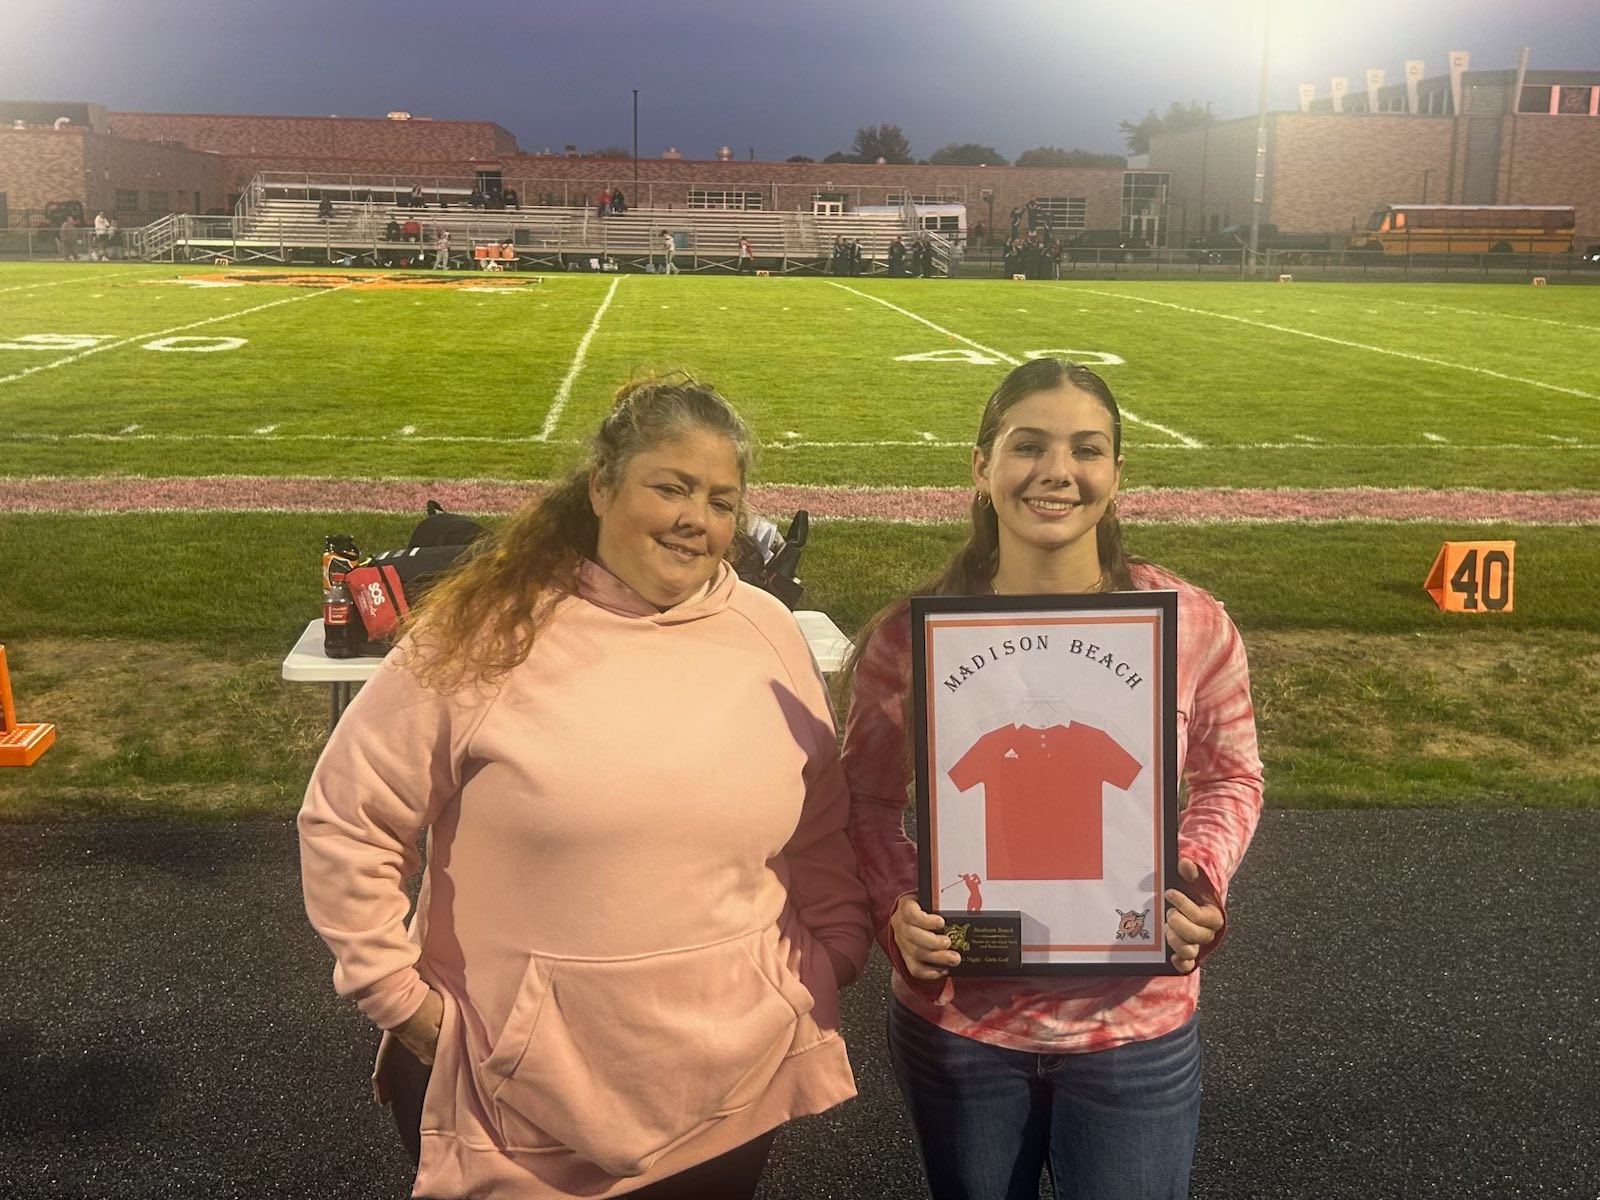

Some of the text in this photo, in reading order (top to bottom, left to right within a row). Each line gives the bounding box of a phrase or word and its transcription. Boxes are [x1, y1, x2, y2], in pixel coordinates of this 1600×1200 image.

[893, 349, 1125, 365] 40
[1450, 549, 1510, 610] 40
[943, 635, 1143, 693] MADISON BEACH
